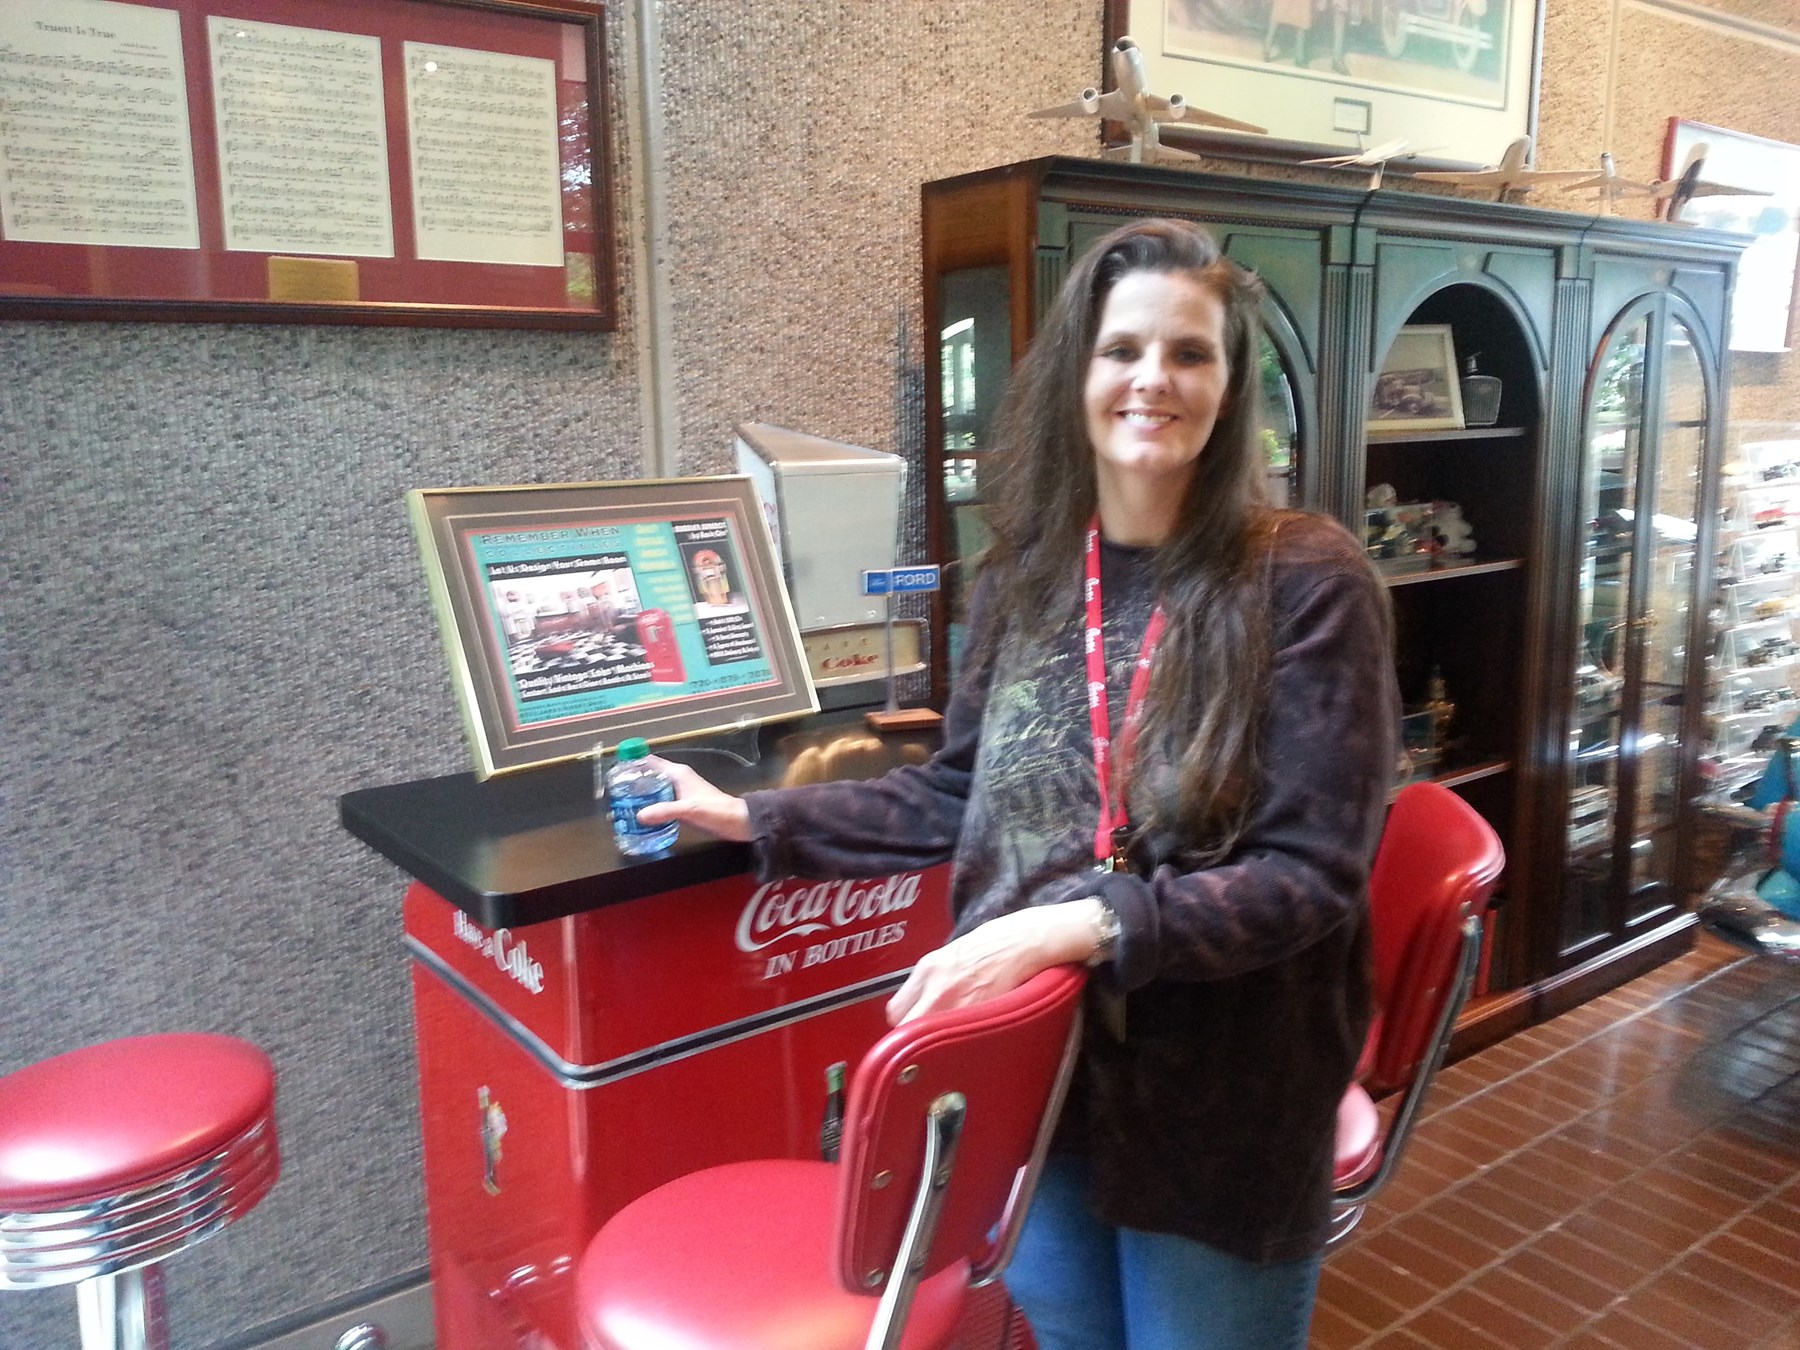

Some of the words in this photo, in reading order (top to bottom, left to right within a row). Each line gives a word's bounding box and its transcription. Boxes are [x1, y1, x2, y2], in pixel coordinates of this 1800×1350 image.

[89, 27, 117, 39] True
[481, 530, 569, 545] REMEMBER
[575, 526, 620, 538] WHEN
[895, 572, 937, 587] FORD
[822, 653, 879, 670] Coke
[735, 873, 922, 953] Coca-Cola
[762, 950, 799, 980] IN
[800, 920, 908, 969] BOTTLES
[493, 928, 544, 994] Coke
